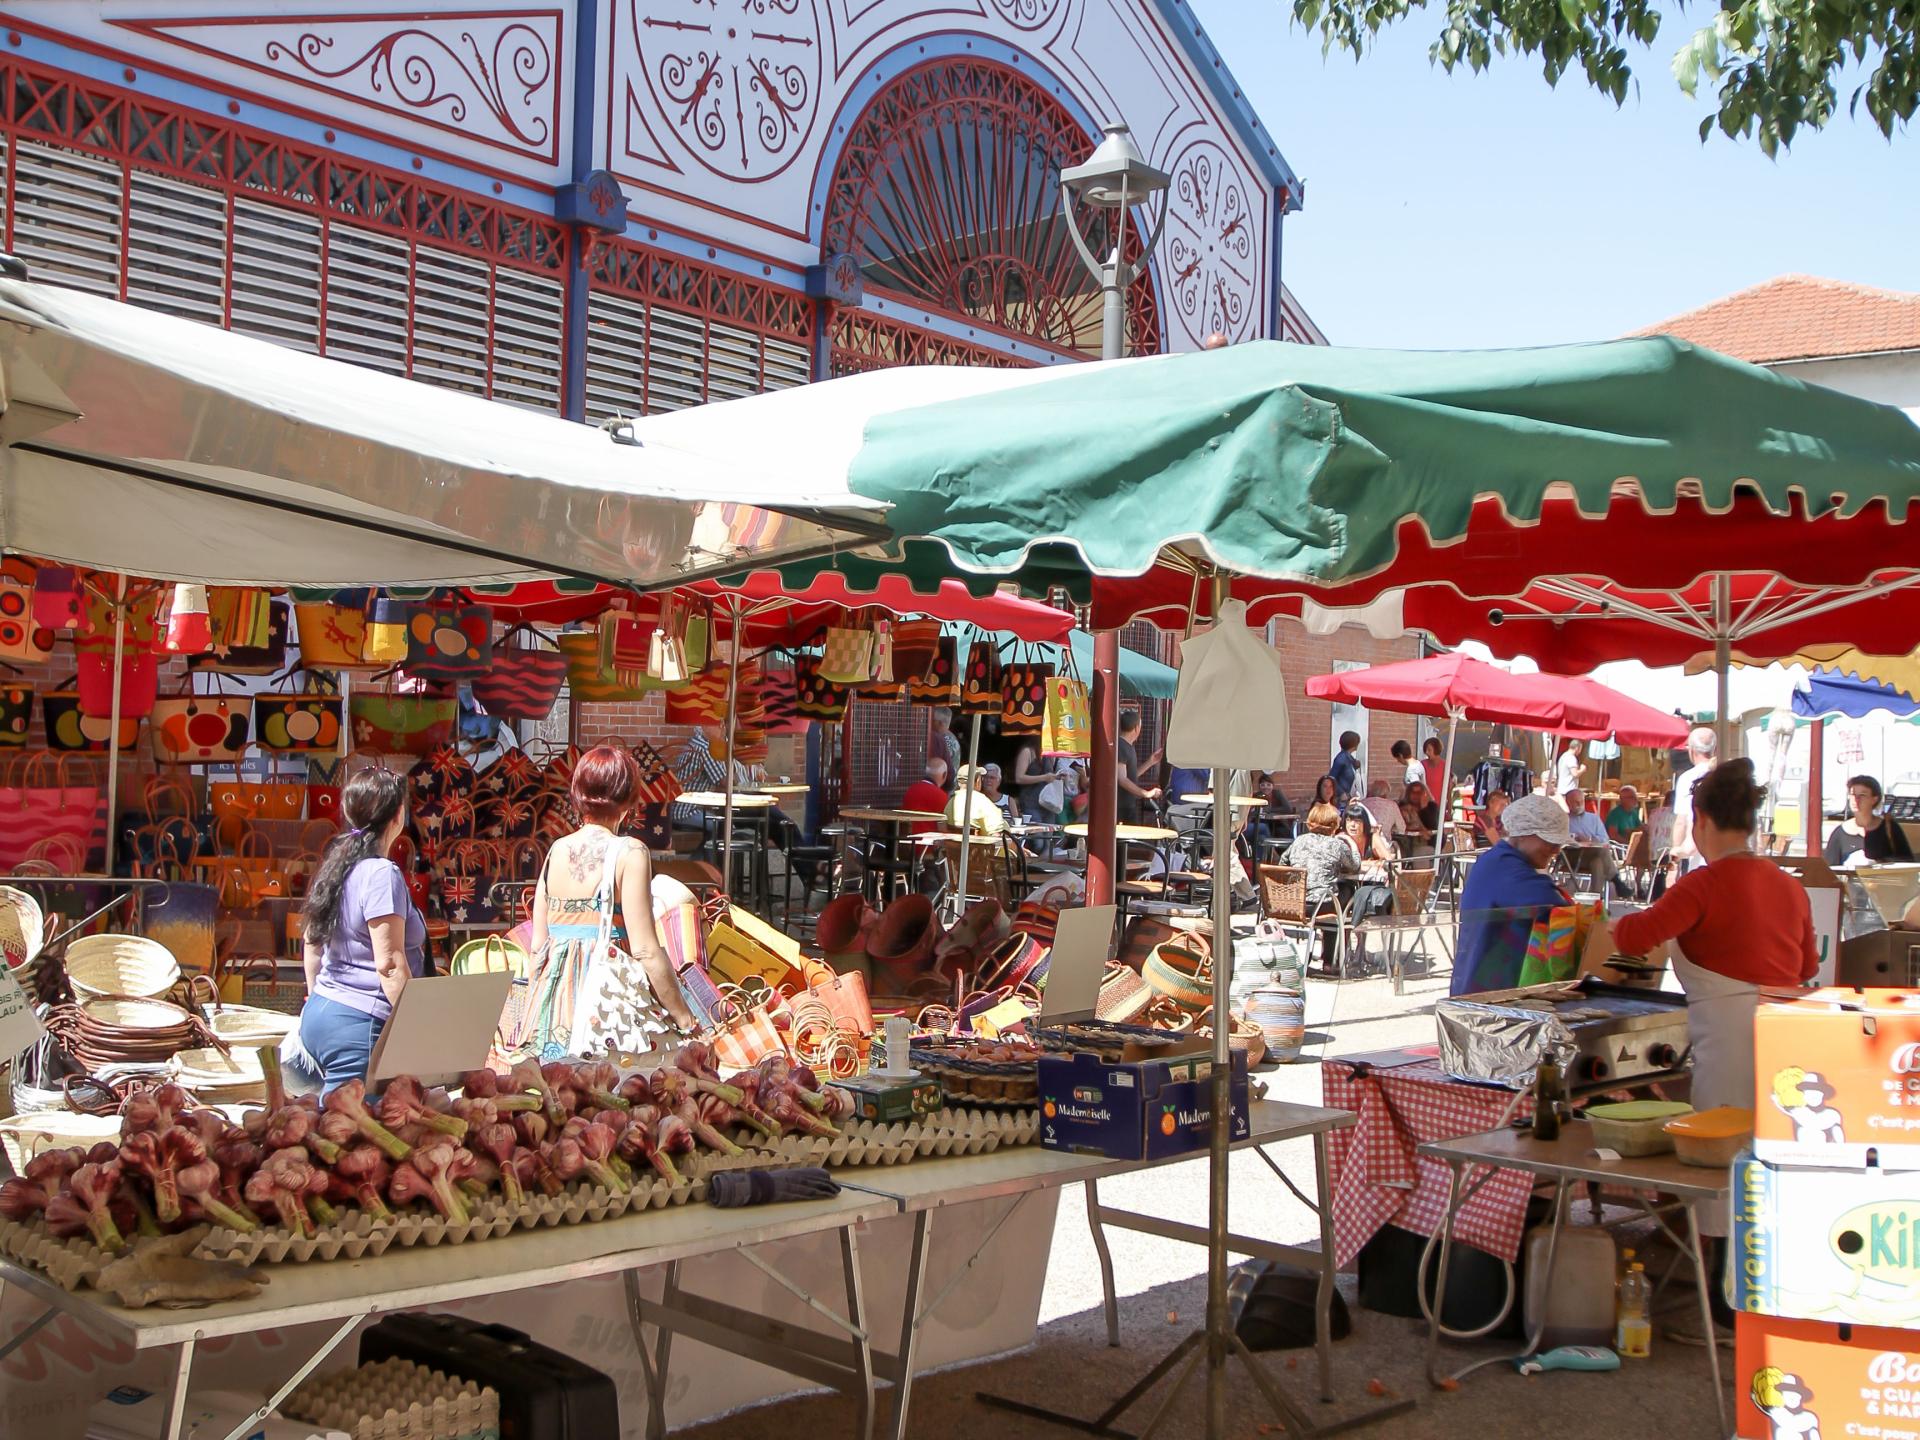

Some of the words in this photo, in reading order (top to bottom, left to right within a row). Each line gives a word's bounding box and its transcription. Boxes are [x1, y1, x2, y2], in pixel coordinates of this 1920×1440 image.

[1058, 1104, 1110, 1120] Mademoiselle
[1735, 1162, 1767, 1314] premium
[1860, 1387, 1881, 1400] DE
